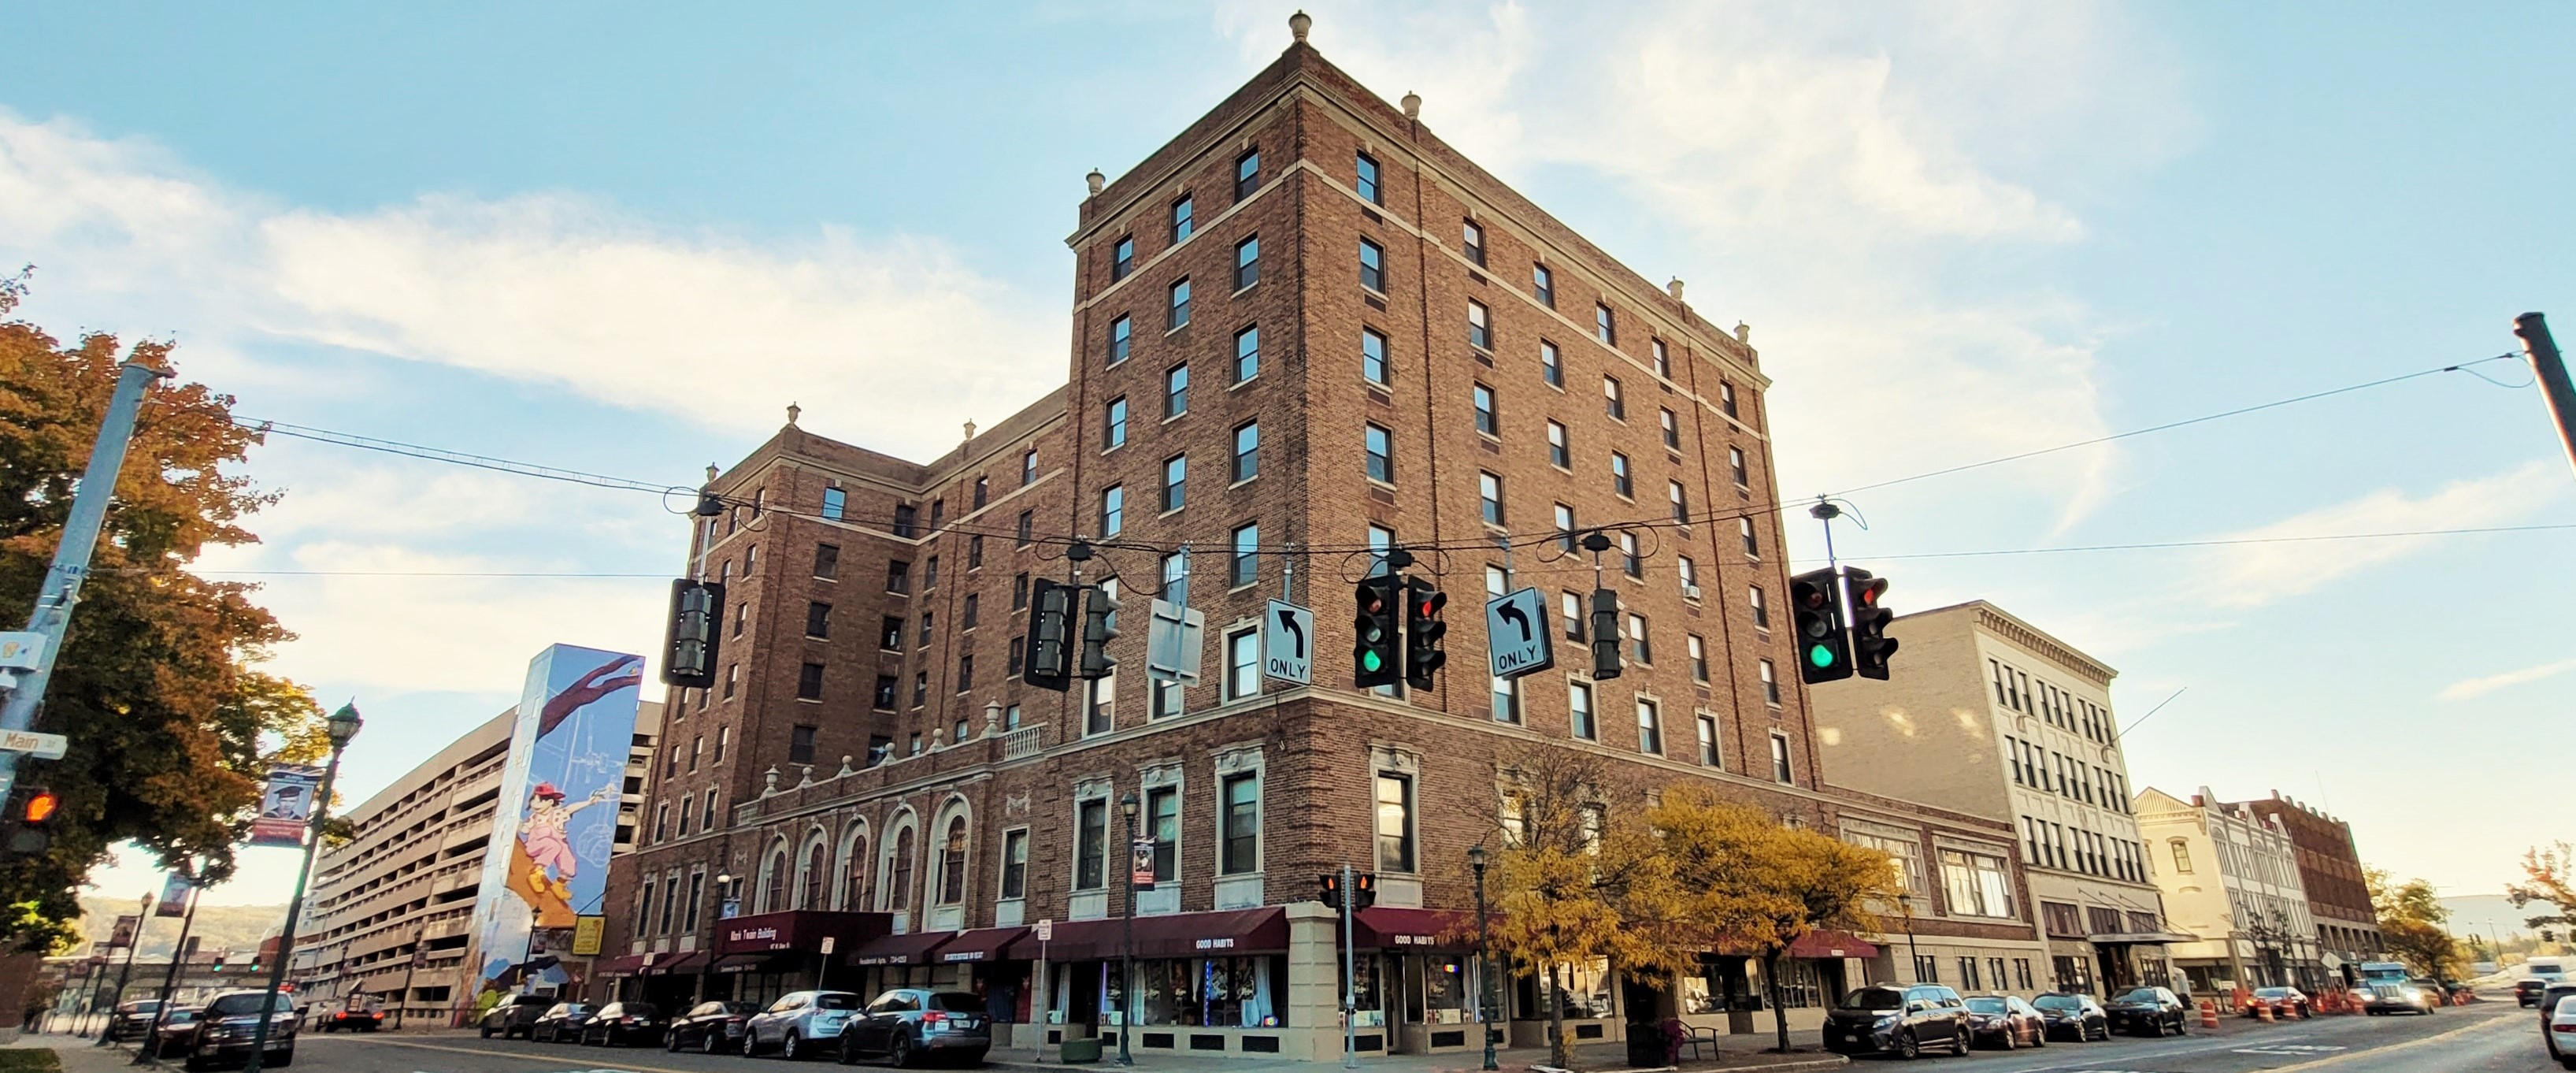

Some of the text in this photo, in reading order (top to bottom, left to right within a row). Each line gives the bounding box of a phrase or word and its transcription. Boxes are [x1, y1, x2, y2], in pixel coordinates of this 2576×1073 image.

[1499, 646, 1536, 670] ONLY
[1270, 659, 1307, 679] ONLY
[5, 732, 39, 749] Main
[730, 926, 777, 941] Mark Twain Building
[1395, 935, 1435, 945] GOOD HABITS
[1195, 937, 1234, 949] GOOD HABITS
